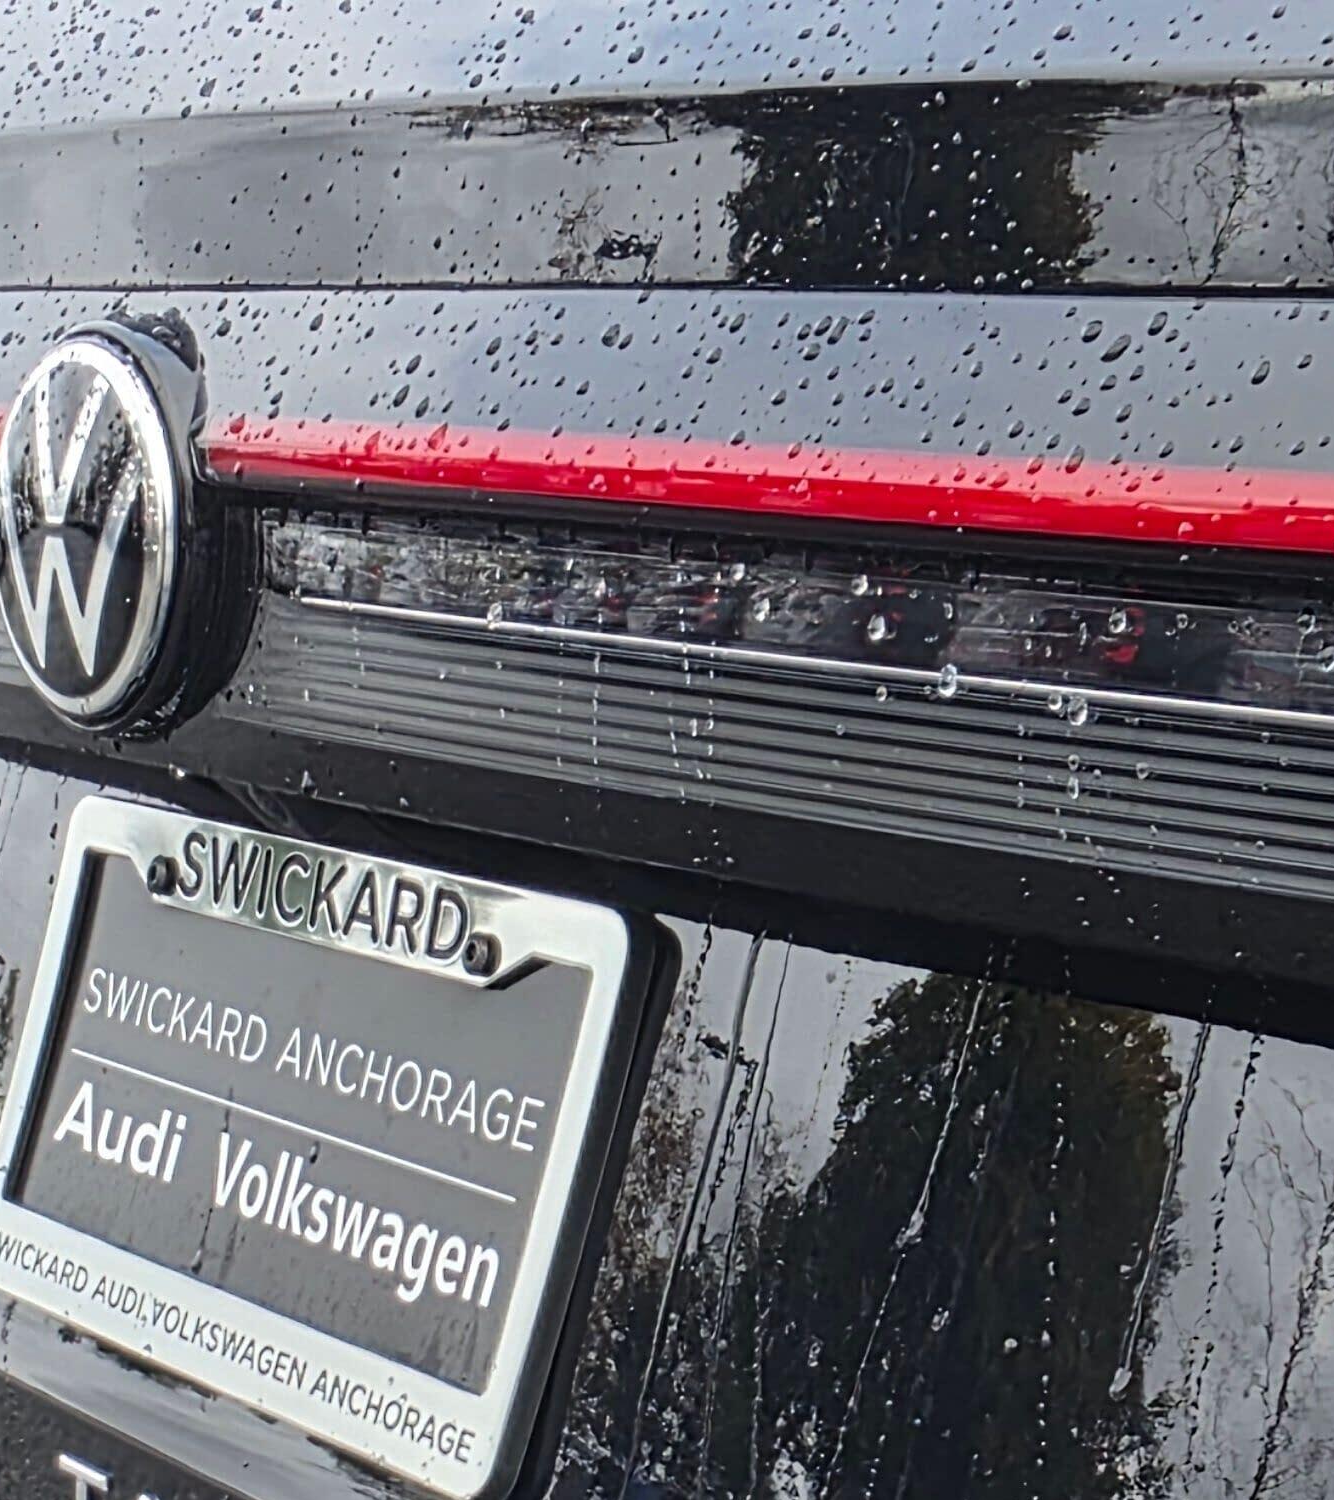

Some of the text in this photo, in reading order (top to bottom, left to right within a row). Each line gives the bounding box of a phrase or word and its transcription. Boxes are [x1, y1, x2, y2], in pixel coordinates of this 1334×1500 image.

[177, 830, 468, 961] SWICKARD
[83, 967, 545, 1152] SWICKARD ANCHORAGE
[53, 1081, 500, 1307] Audi Volkswagen
[309, 1369, 476, 1464] ANCHORAGE
